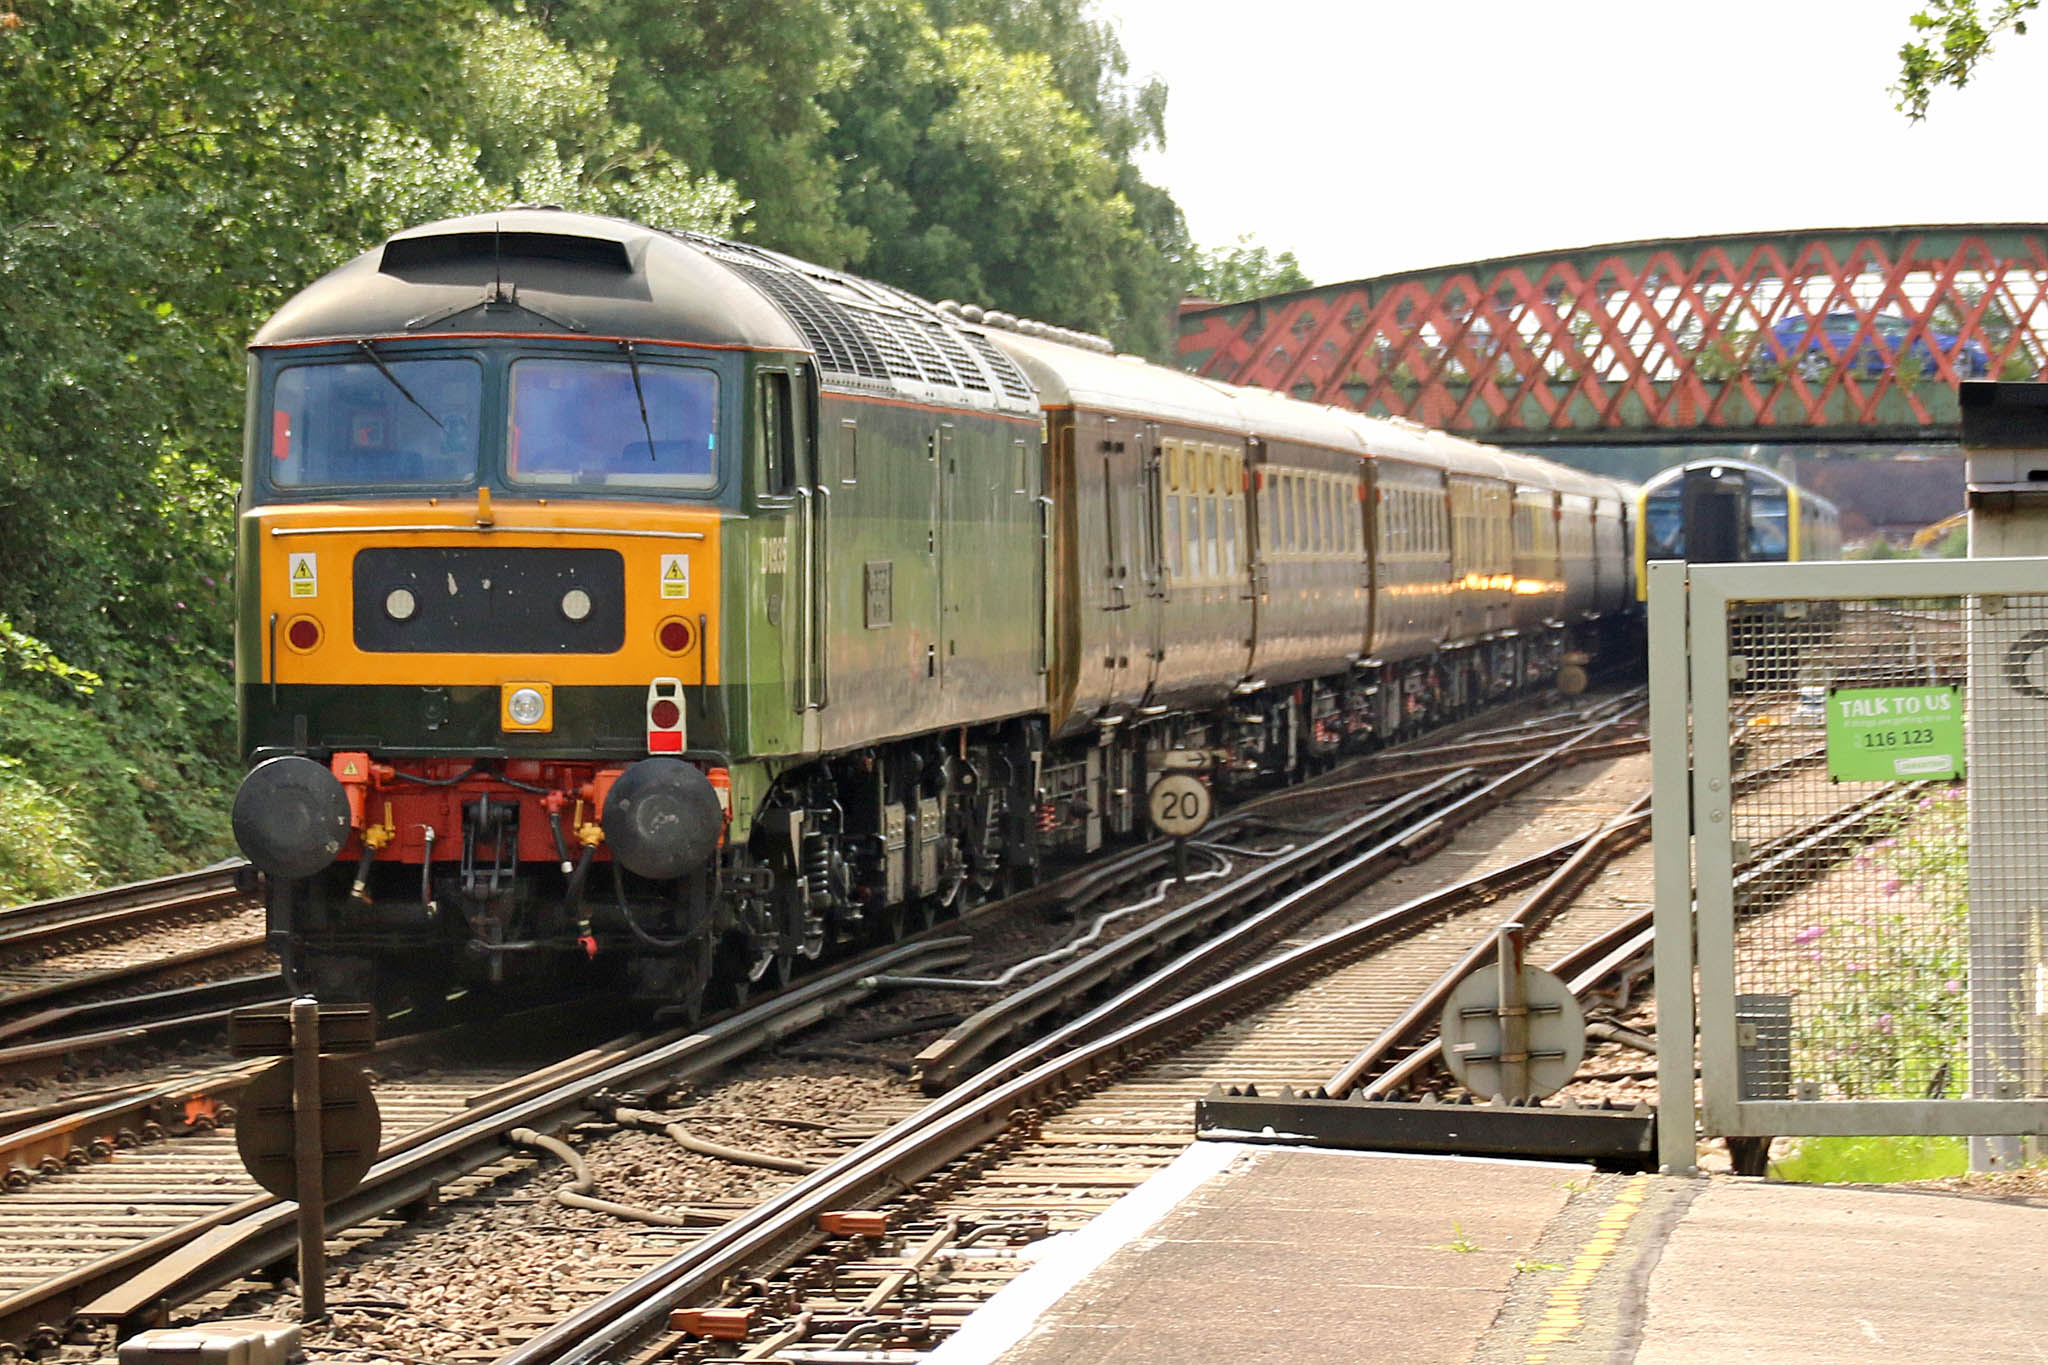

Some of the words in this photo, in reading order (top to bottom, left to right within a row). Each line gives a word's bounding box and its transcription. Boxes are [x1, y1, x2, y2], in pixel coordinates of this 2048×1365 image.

[1840, 697, 1889, 718] TALK
[1892, 696, 1920, 714] TO
[1924, 693, 1952, 711] US
[1864, 731, 1897, 748] 116
[1902, 728, 1934, 745] 123
[1161, 791, 1199, 820] 20
